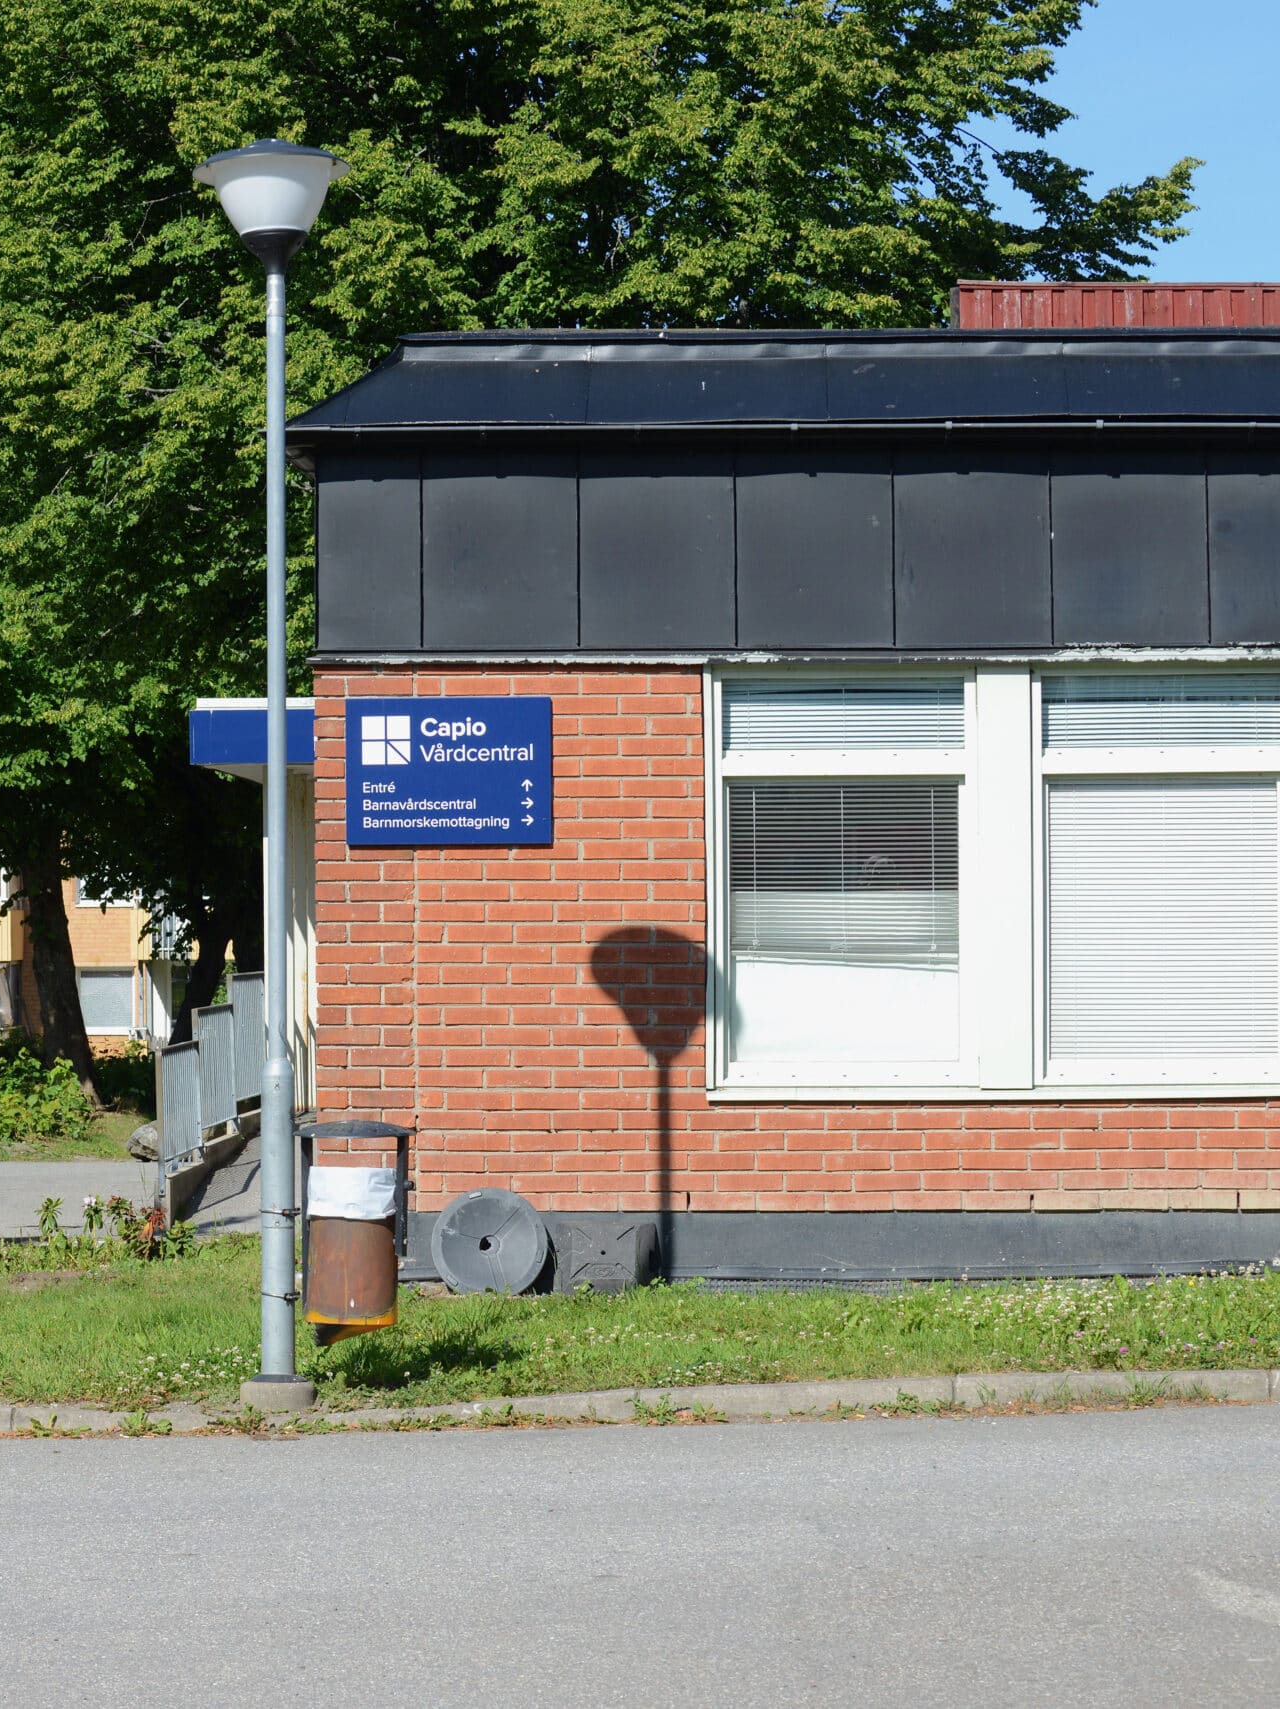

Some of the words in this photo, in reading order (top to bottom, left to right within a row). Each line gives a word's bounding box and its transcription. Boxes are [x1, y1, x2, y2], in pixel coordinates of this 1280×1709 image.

[420, 717, 487, 741] Capio
[420, 743, 534, 763] Vårdcentral
[362, 781, 396, 793] Entré
[362, 798, 477, 811] Barnavårdscentral
[362, 815, 510, 830] Barnmorskemottagning
